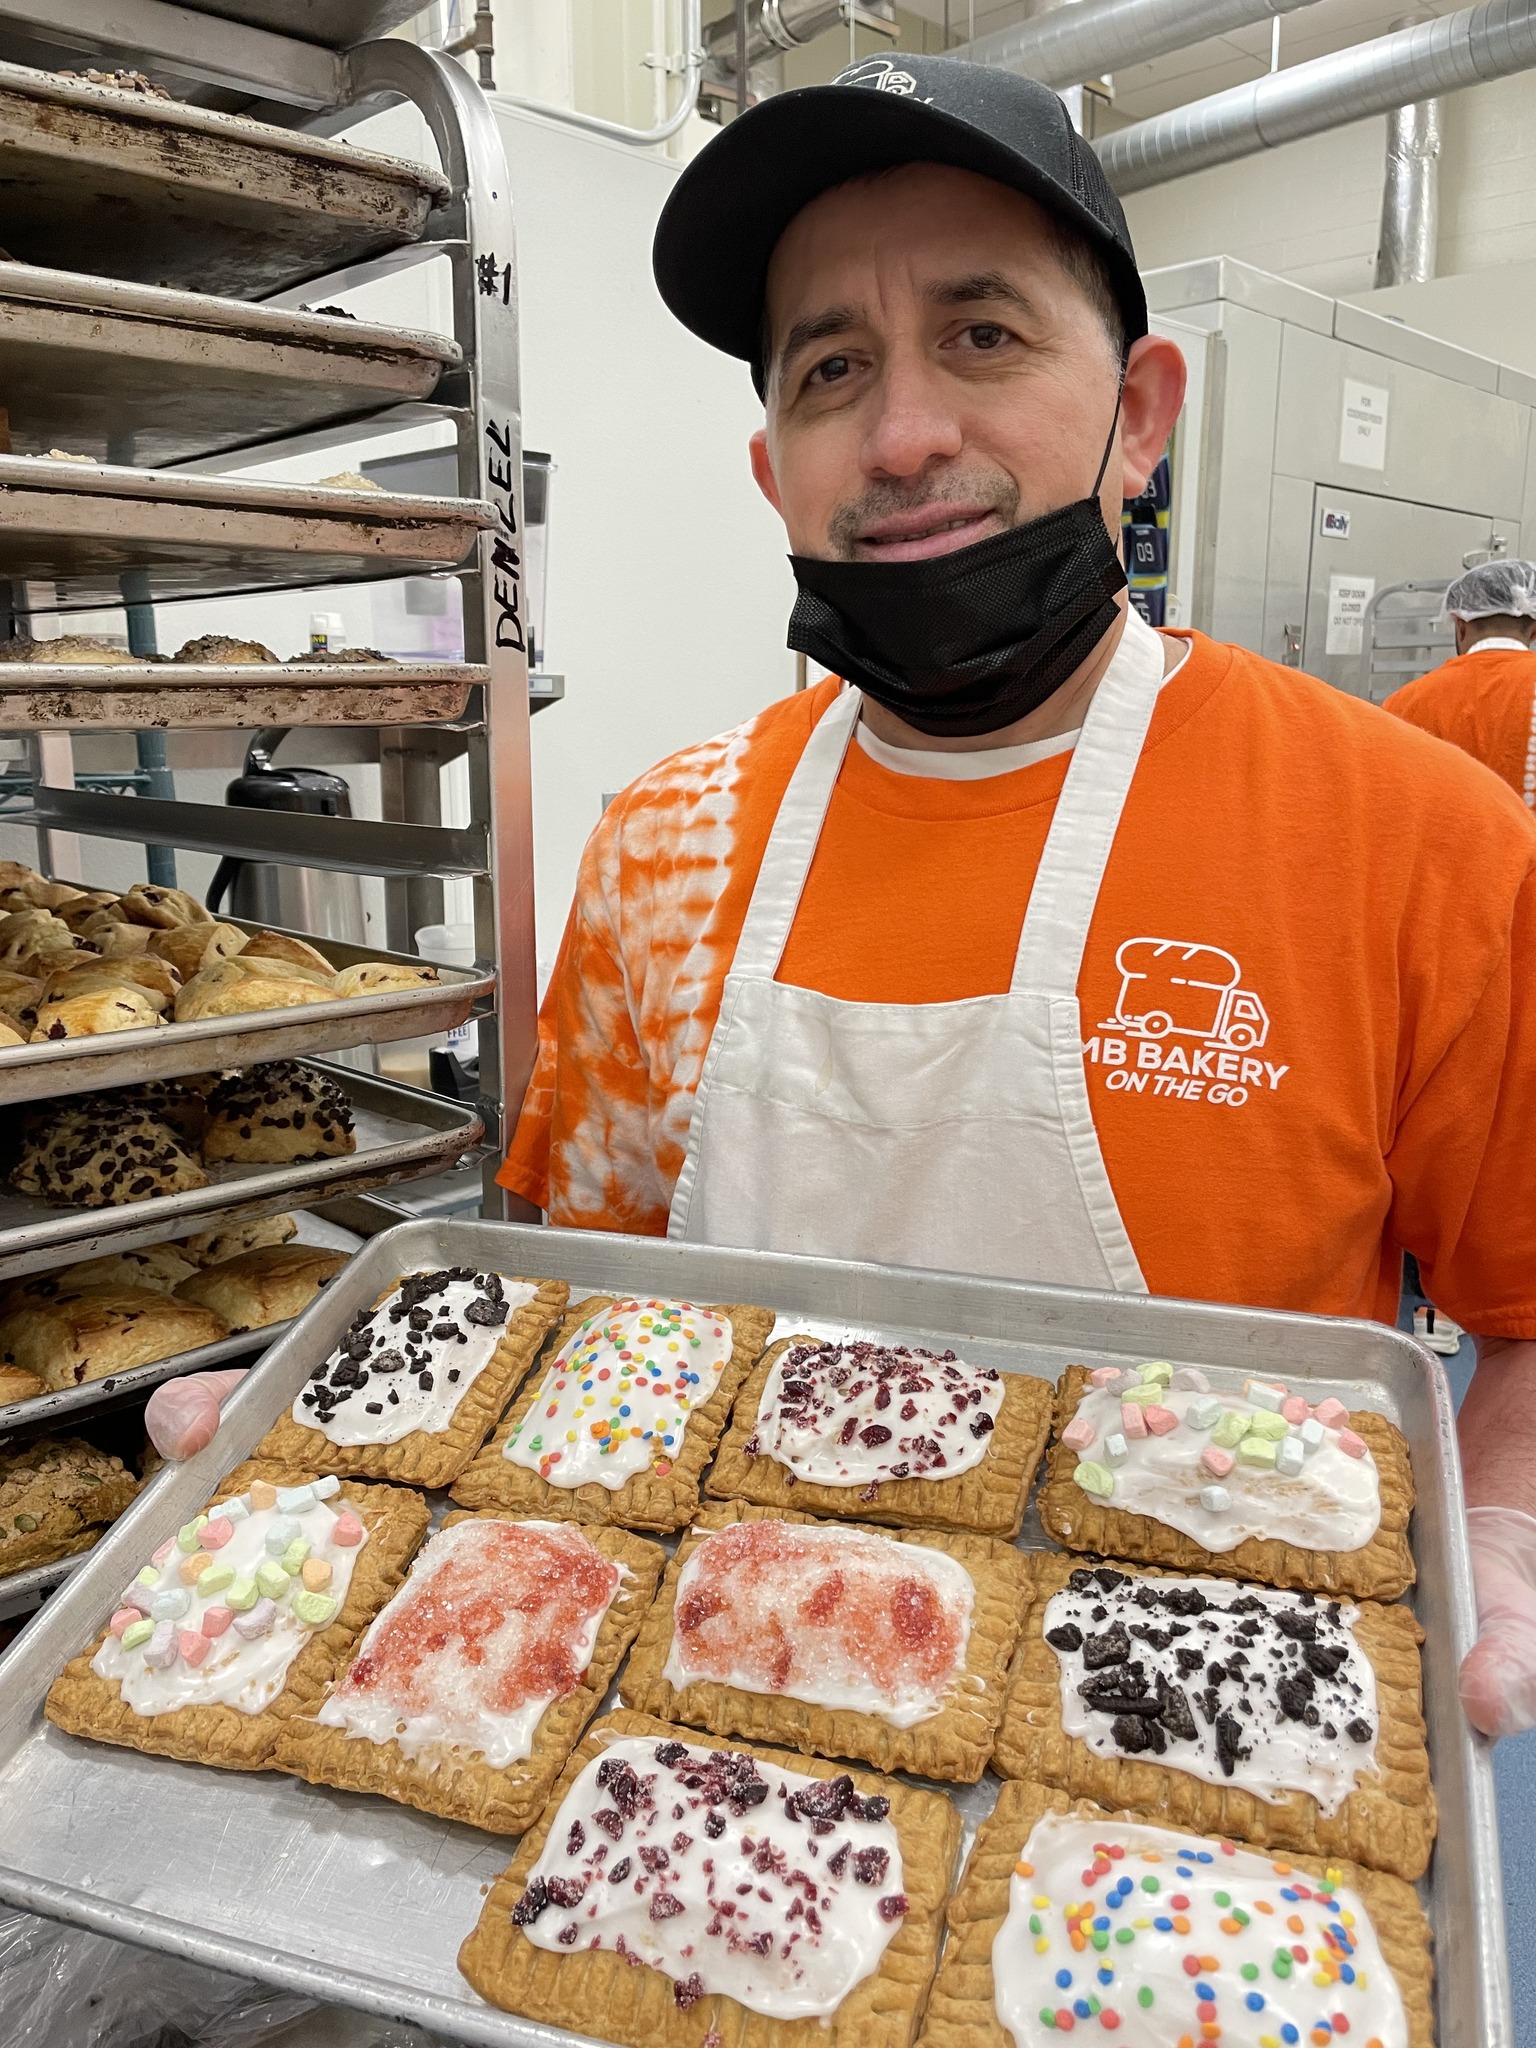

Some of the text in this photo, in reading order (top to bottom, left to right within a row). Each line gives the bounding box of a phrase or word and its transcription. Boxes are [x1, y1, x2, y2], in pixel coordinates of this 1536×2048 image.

[1136, 542, 1155, 562] 09
[1137, 1041, 1290, 1090] BAKERY
[1105, 1069, 1249, 1107] ON THE GO
